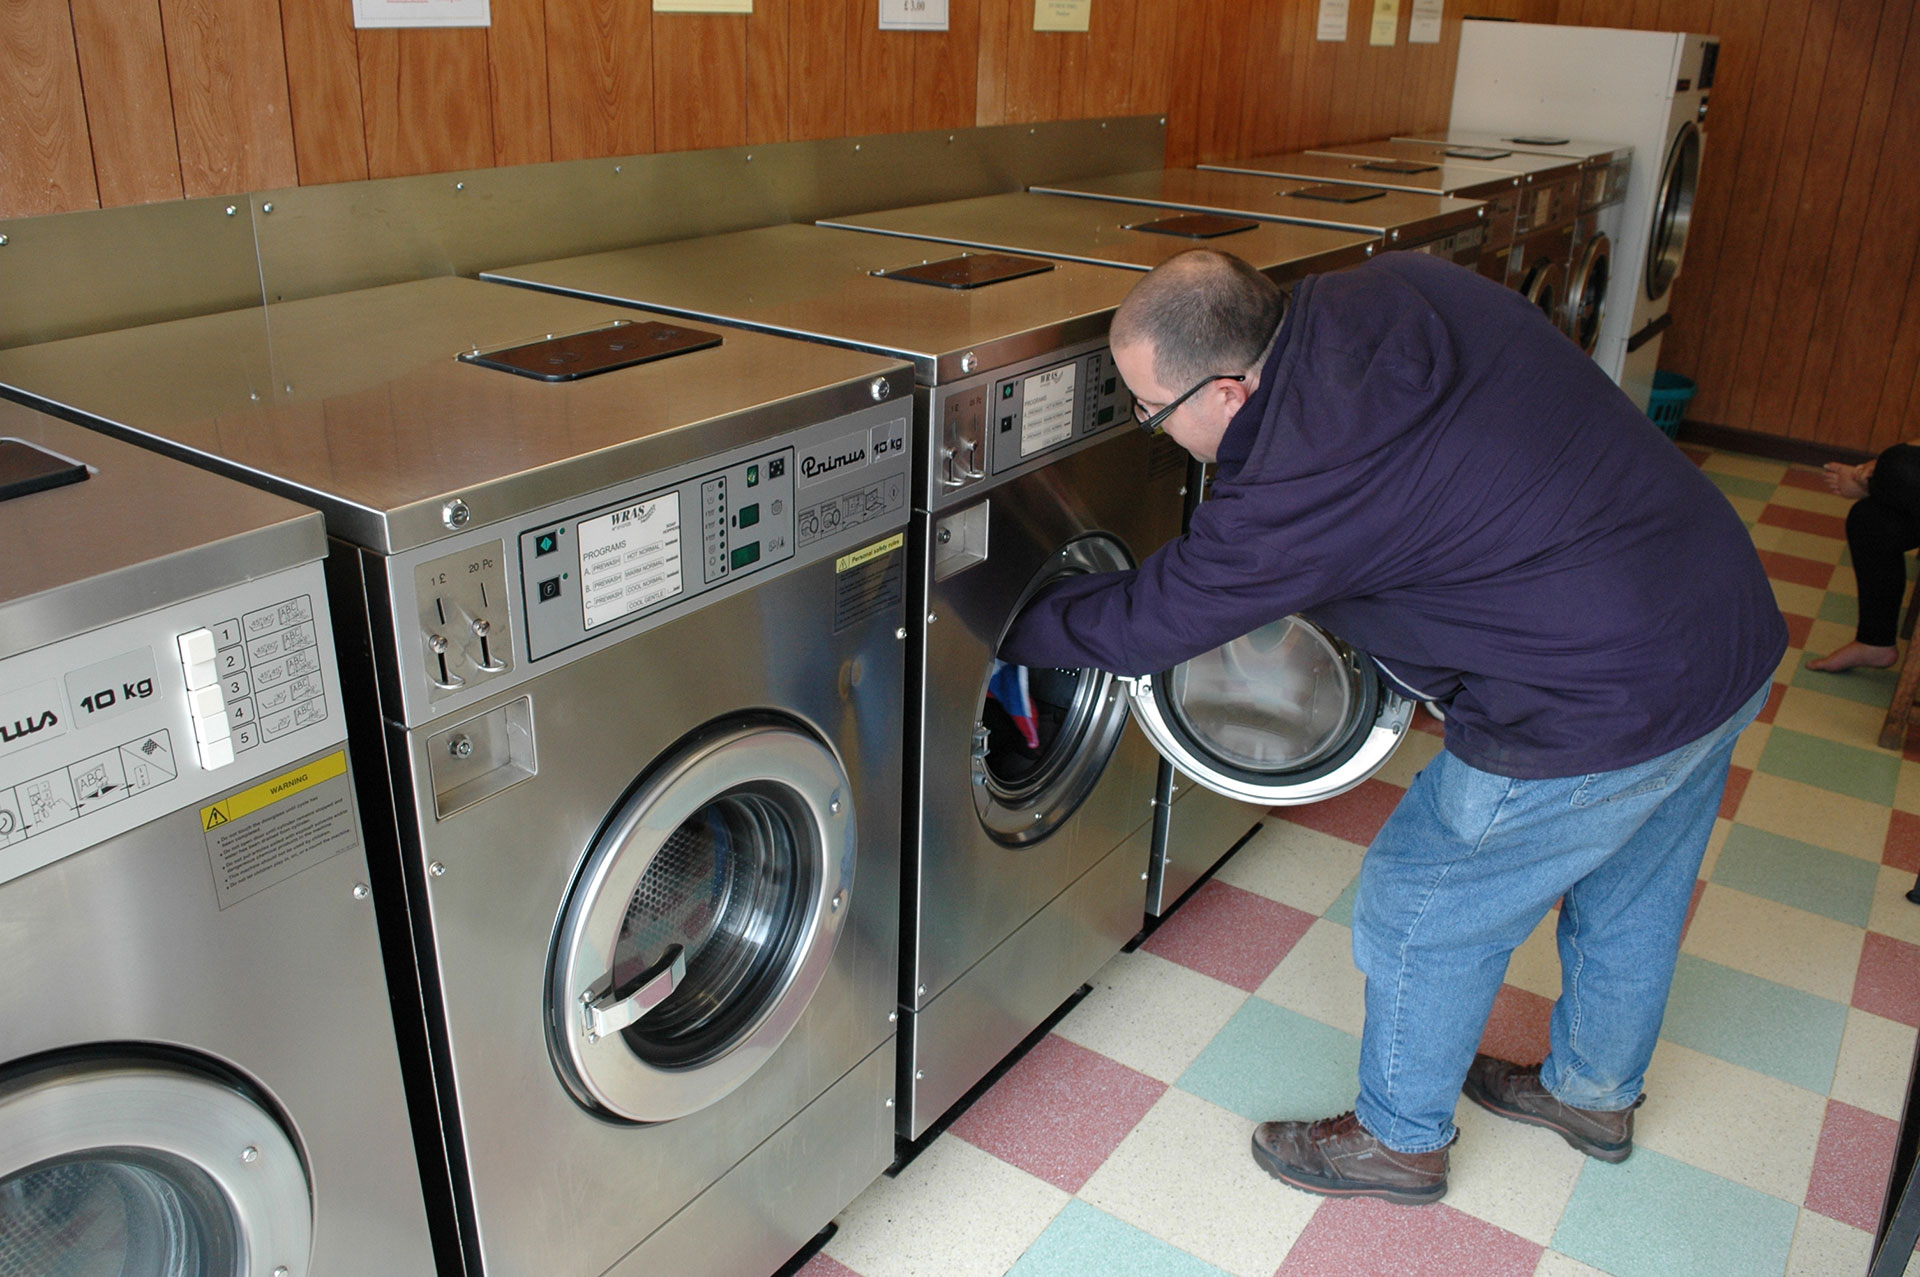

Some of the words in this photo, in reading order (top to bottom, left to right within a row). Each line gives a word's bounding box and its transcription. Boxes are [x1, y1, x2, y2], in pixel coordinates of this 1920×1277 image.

[890, 437, 902, 450] kg
[801, 449, 865, 478] Primus
[611, 505, 645, 525] WRAS
[583, 540, 627, 560] PROGRAMS
[468, 563, 480, 574] 20
[439, 573, 447, 584] £
[222, 629, 229, 640] 1
[226, 655, 235, 668] 2
[230, 682, 240, 693] 3
[80, 688, 116, 713] 10
[123, 678, 153, 700] kg
[235, 707, 243, 718] 4
[240, 732, 249, 744] 5
[79, 768, 105, 791] ABC
[270, 774, 308, 795] WARNING
